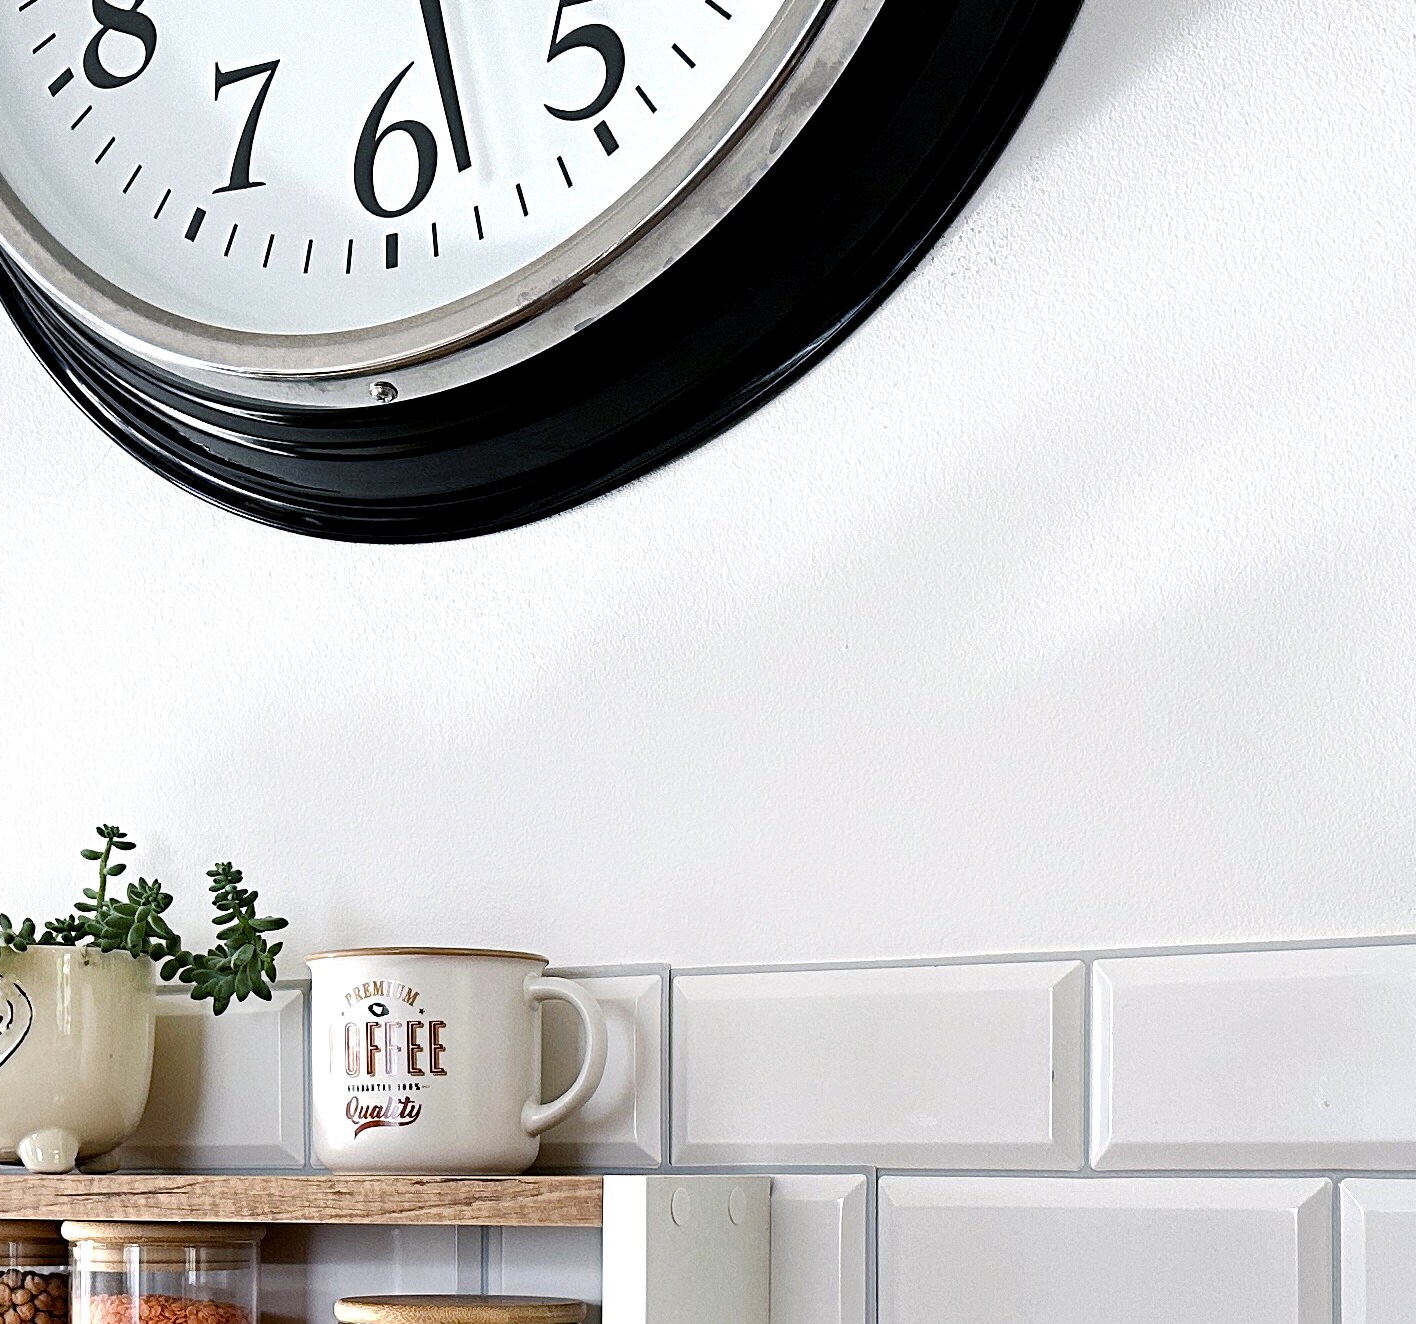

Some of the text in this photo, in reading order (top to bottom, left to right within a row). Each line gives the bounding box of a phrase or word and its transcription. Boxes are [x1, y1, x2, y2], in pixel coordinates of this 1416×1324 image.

[83, 0, 157, 89] 8
[543, 0, 626, 122] 5
[212, 59, 281, 194] 7
[353, 60, 438, 218] 6
[344, 980, 420, 1008] PREMIUM
[329, 1020, 448, 1078] OFFEE
[345, 1095, 423, 1138] Quality
